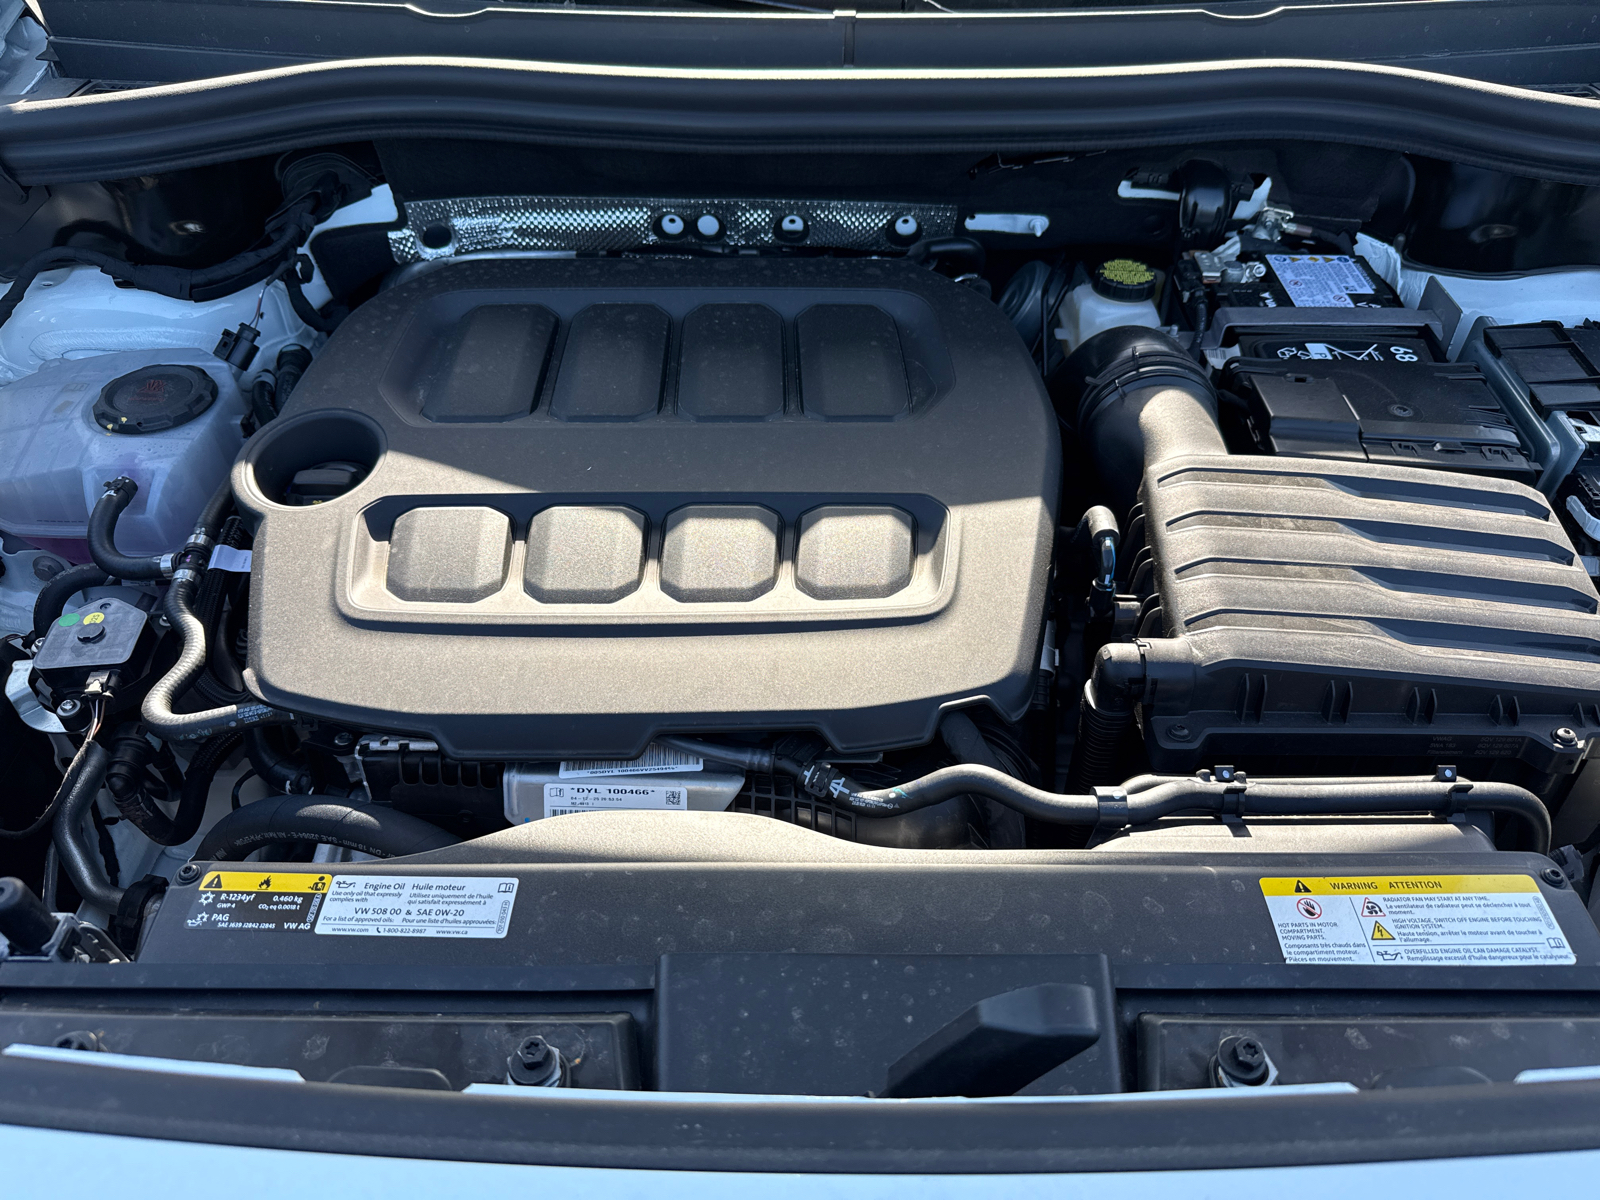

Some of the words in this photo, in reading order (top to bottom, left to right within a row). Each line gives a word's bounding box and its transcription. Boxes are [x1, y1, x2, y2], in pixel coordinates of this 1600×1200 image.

[364, 882, 392, 891] Engine
[1330, 882, 1378, 890] WARNING
[1389, 881, 1442, 889] ATTENTION
[220, 894, 256, 902] R-1234yf
[371, 907, 388, 915] 508
[211, 913, 230, 921] PAG
[298, 922, 310, 930] AG
